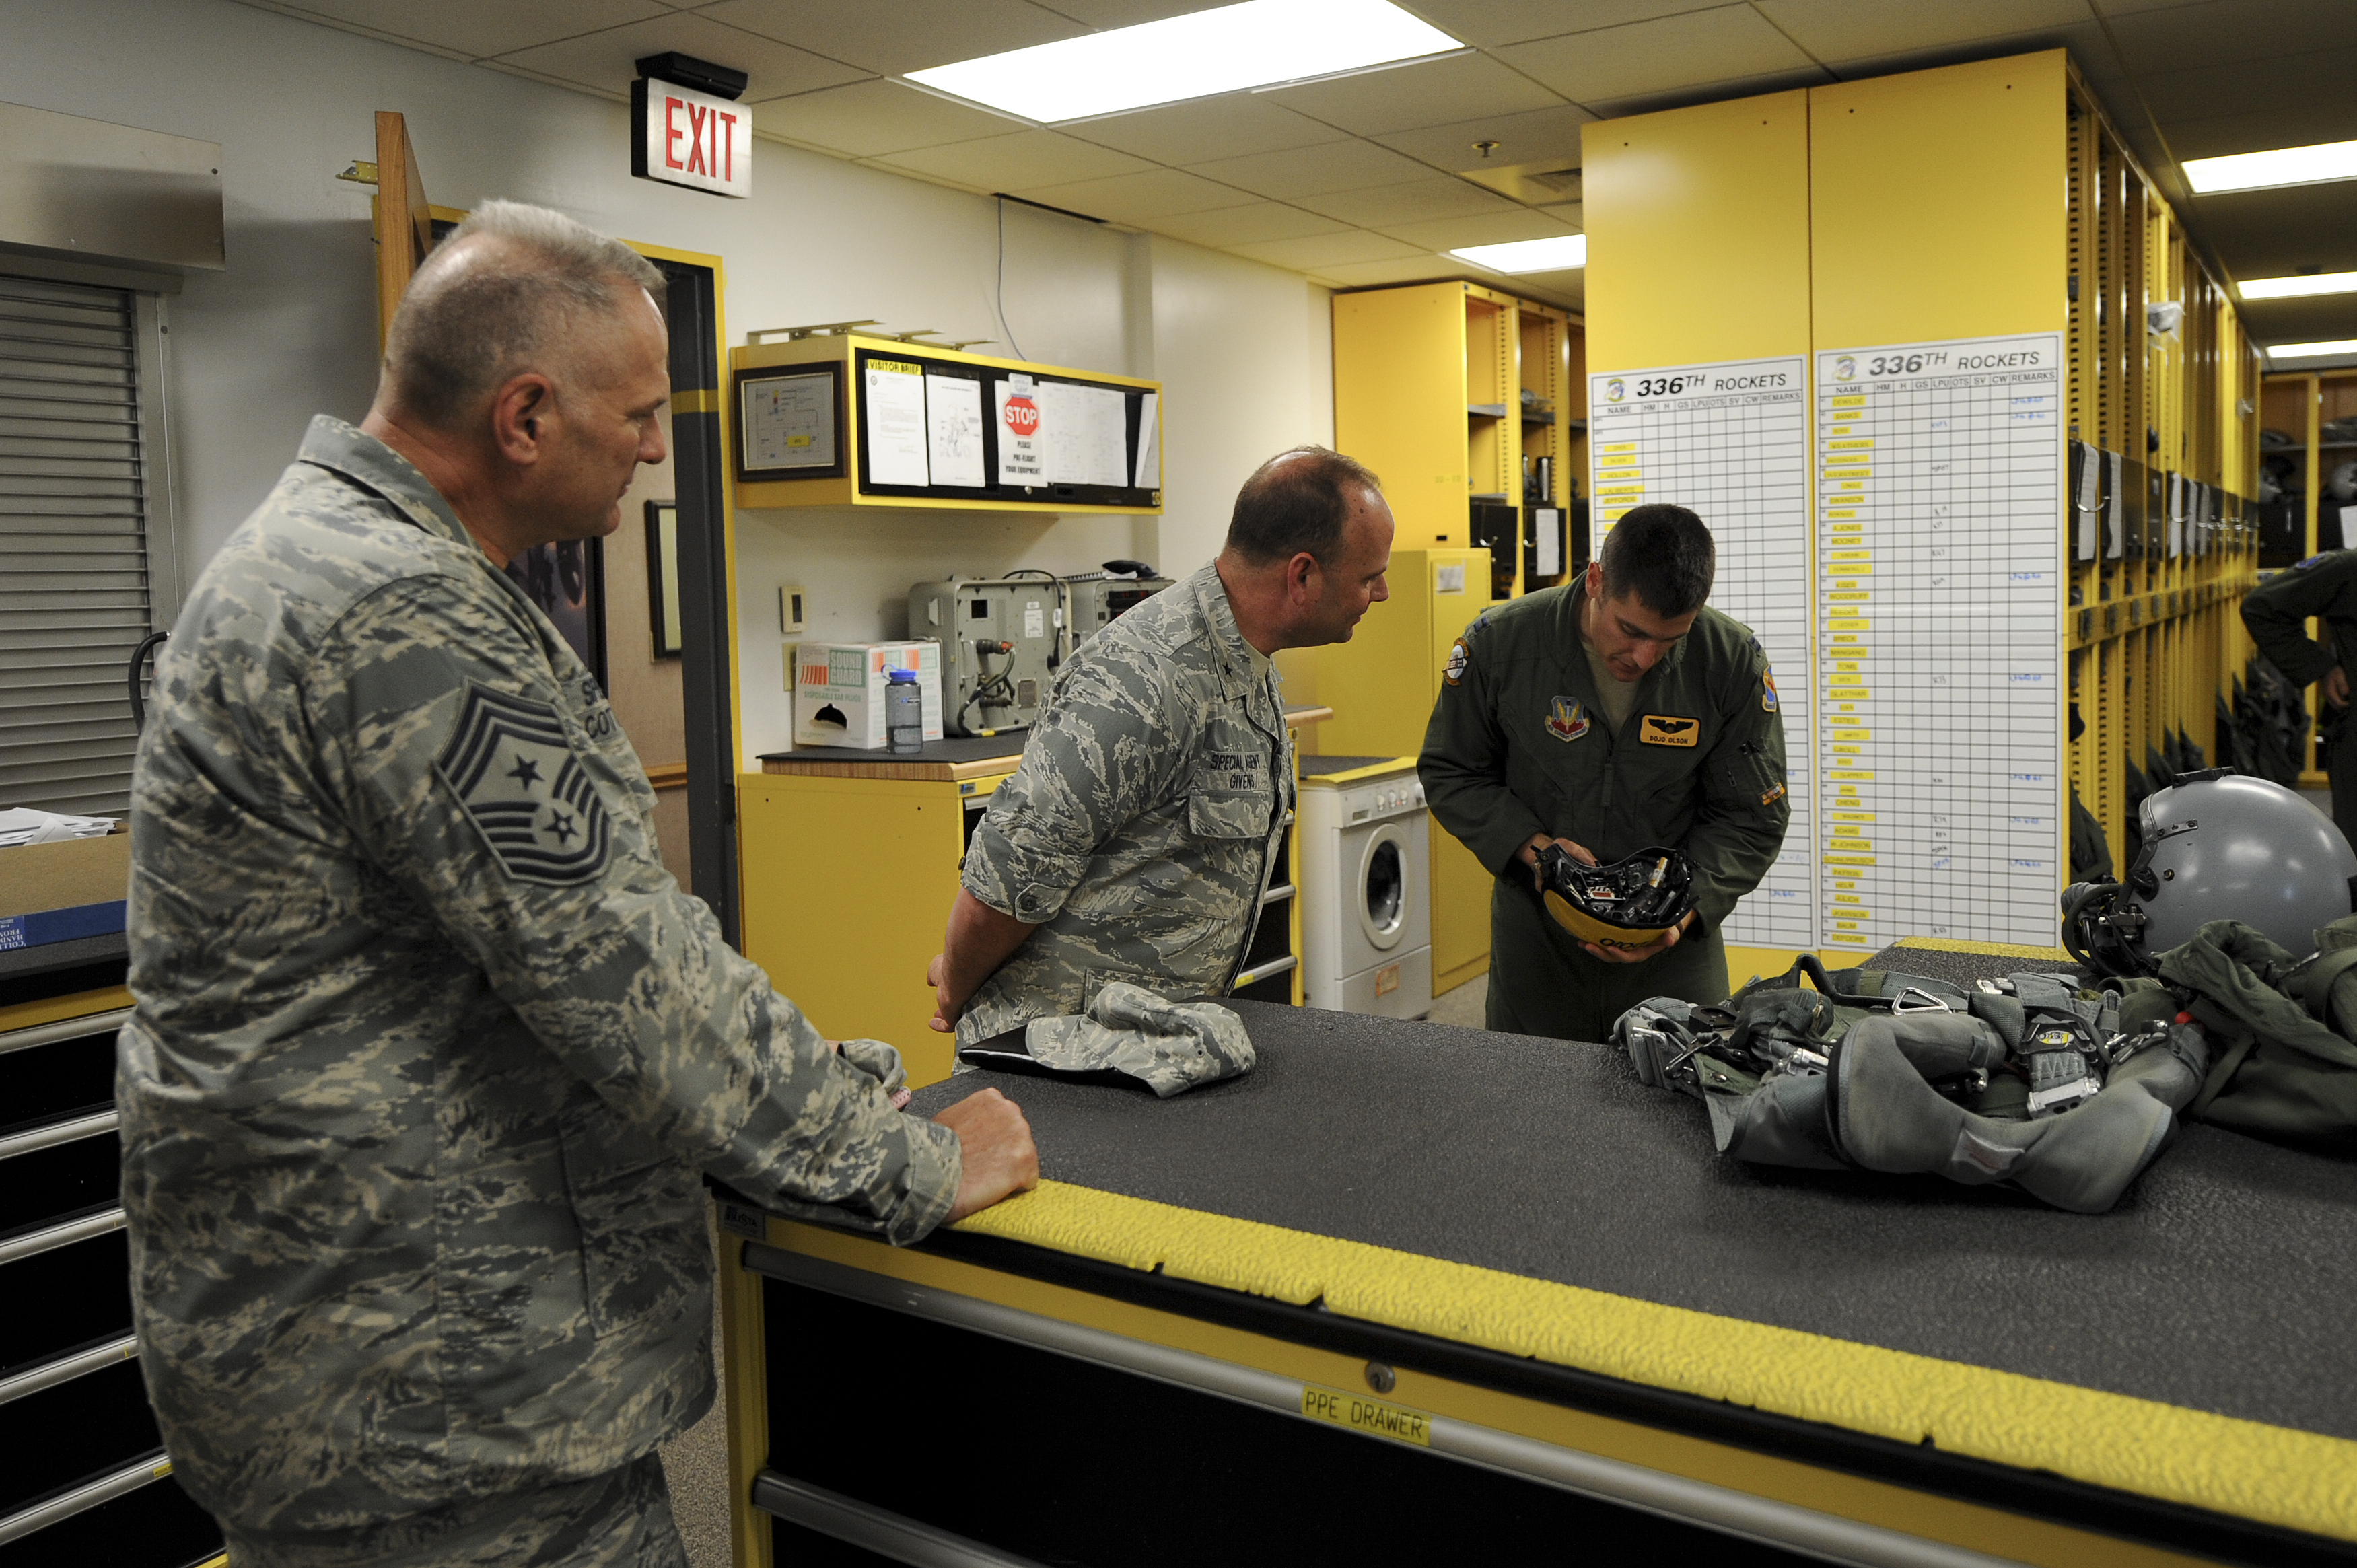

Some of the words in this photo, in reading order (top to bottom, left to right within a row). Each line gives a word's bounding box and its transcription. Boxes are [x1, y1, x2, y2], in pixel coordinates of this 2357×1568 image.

[666, 96, 736, 182] EXIT
[870, 361, 899, 372] VISITOR
[901, 363, 919, 373] BRIEF
[1957, 351, 2039, 370] ROCKETS
[1714, 374, 1786, 392] ROCKETS
[1835, 386, 1862, 394] NAME
[1932, 379, 1949, 388] LPU
[1952, 378, 1969, 386] OTS
[1973, 376, 1986, 384] SV
[1992, 375, 2008, 383] CW
[2011, 371, 2055, 383] REMARKS
[1607, 405, 1631, 414] NAME
[1677, 401, 1689, 409] GS
[1693, 400, 1708, 408] LPU
[1728, 397, 1740, 405] SV
[1745, 396, 1759, 404] CW
[1761, 392, 1800, 402] REMARKS
[1006, 405, 1038, 425] STOP
[831, 651, 862, 668] SOUND
[830, 668, 862, 686] GUARD
[1650, 735, 1666, 743] DOJO
[1211, 754, 1244, 770] SPECIAL
[1229, 774, 1255, 789] GIVENS
[1306, 1391, 1339, 1419] PPE
[1351, 1401, 1423, 1438] DRAWER
